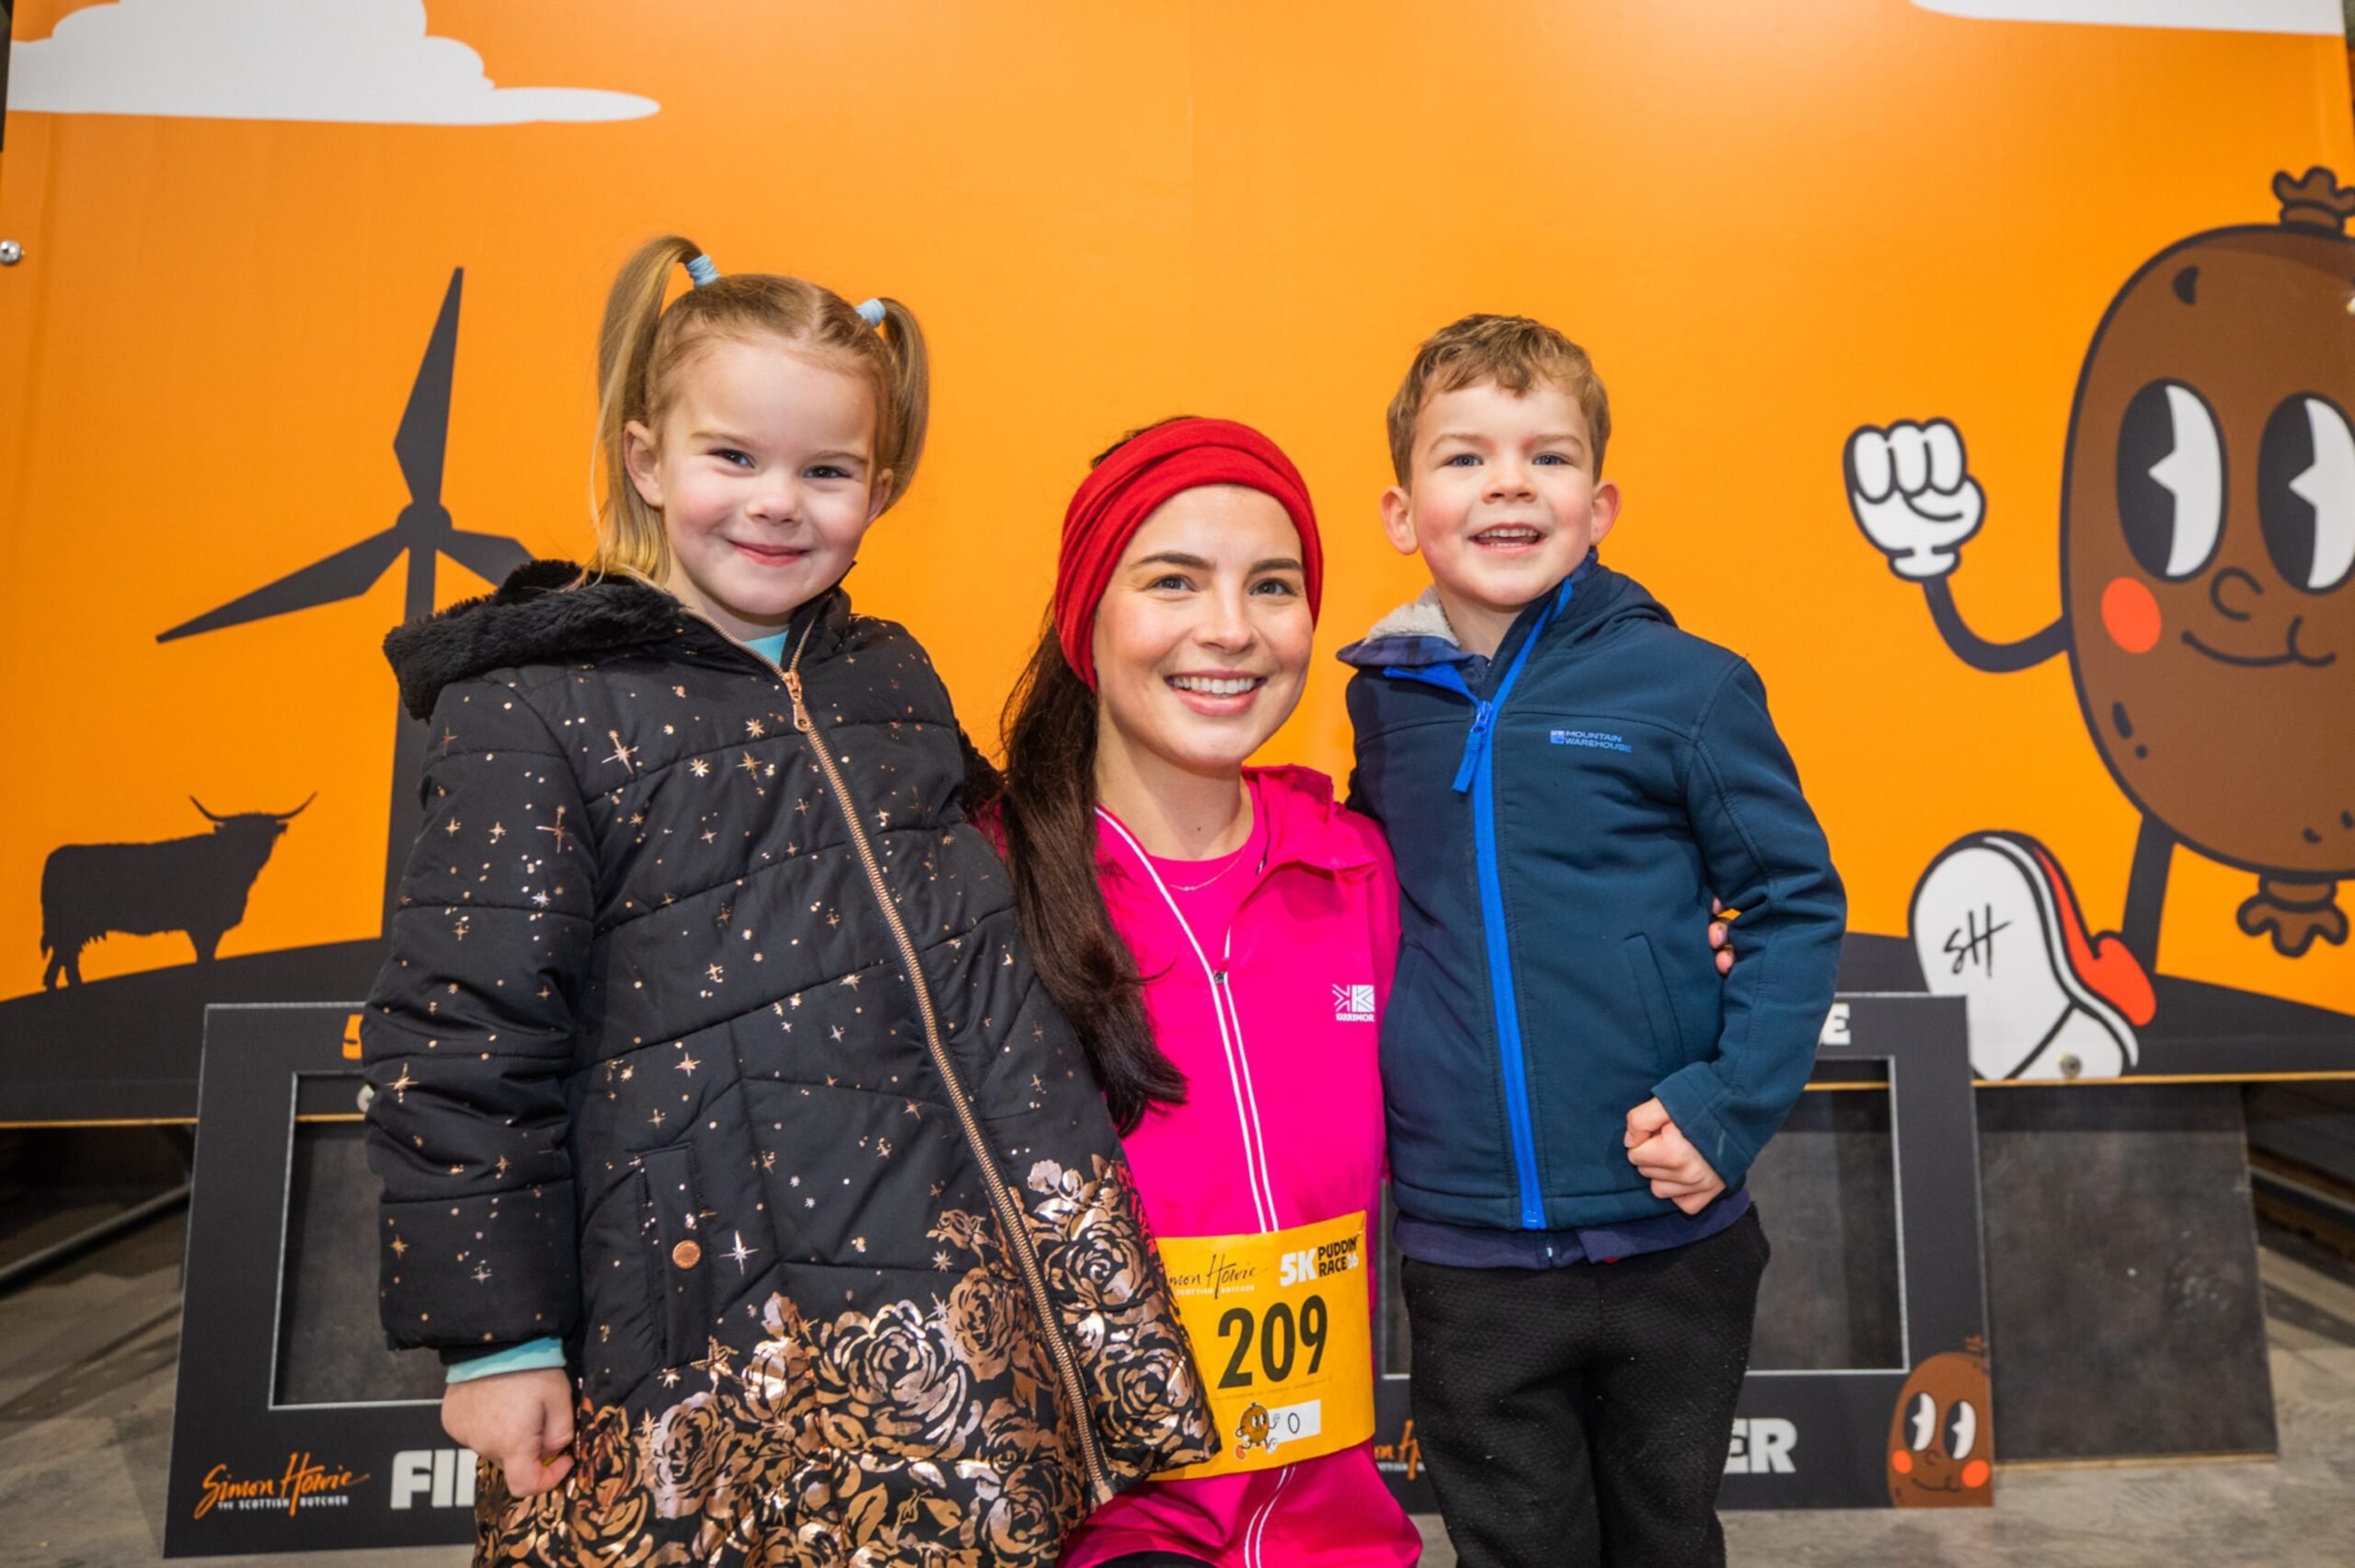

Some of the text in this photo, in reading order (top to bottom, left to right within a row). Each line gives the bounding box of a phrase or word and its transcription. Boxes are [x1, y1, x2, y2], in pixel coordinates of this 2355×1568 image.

[1565, 738, 1632, 752] WAREHOUSE
[1566, 730, 1622, 742] MOUNTAIN
[1280, 1248, 1317, 1288] 5K
[1319, 1256, 1348, 1277] RACE
[1217, 1295, 1327, 1390] 209
[194, 1451, 370, 1519] Simon Howie
[238, 1498, 290, 1510] SCOTTISH
[300, 1495, 349, 1507] BUTCHER
